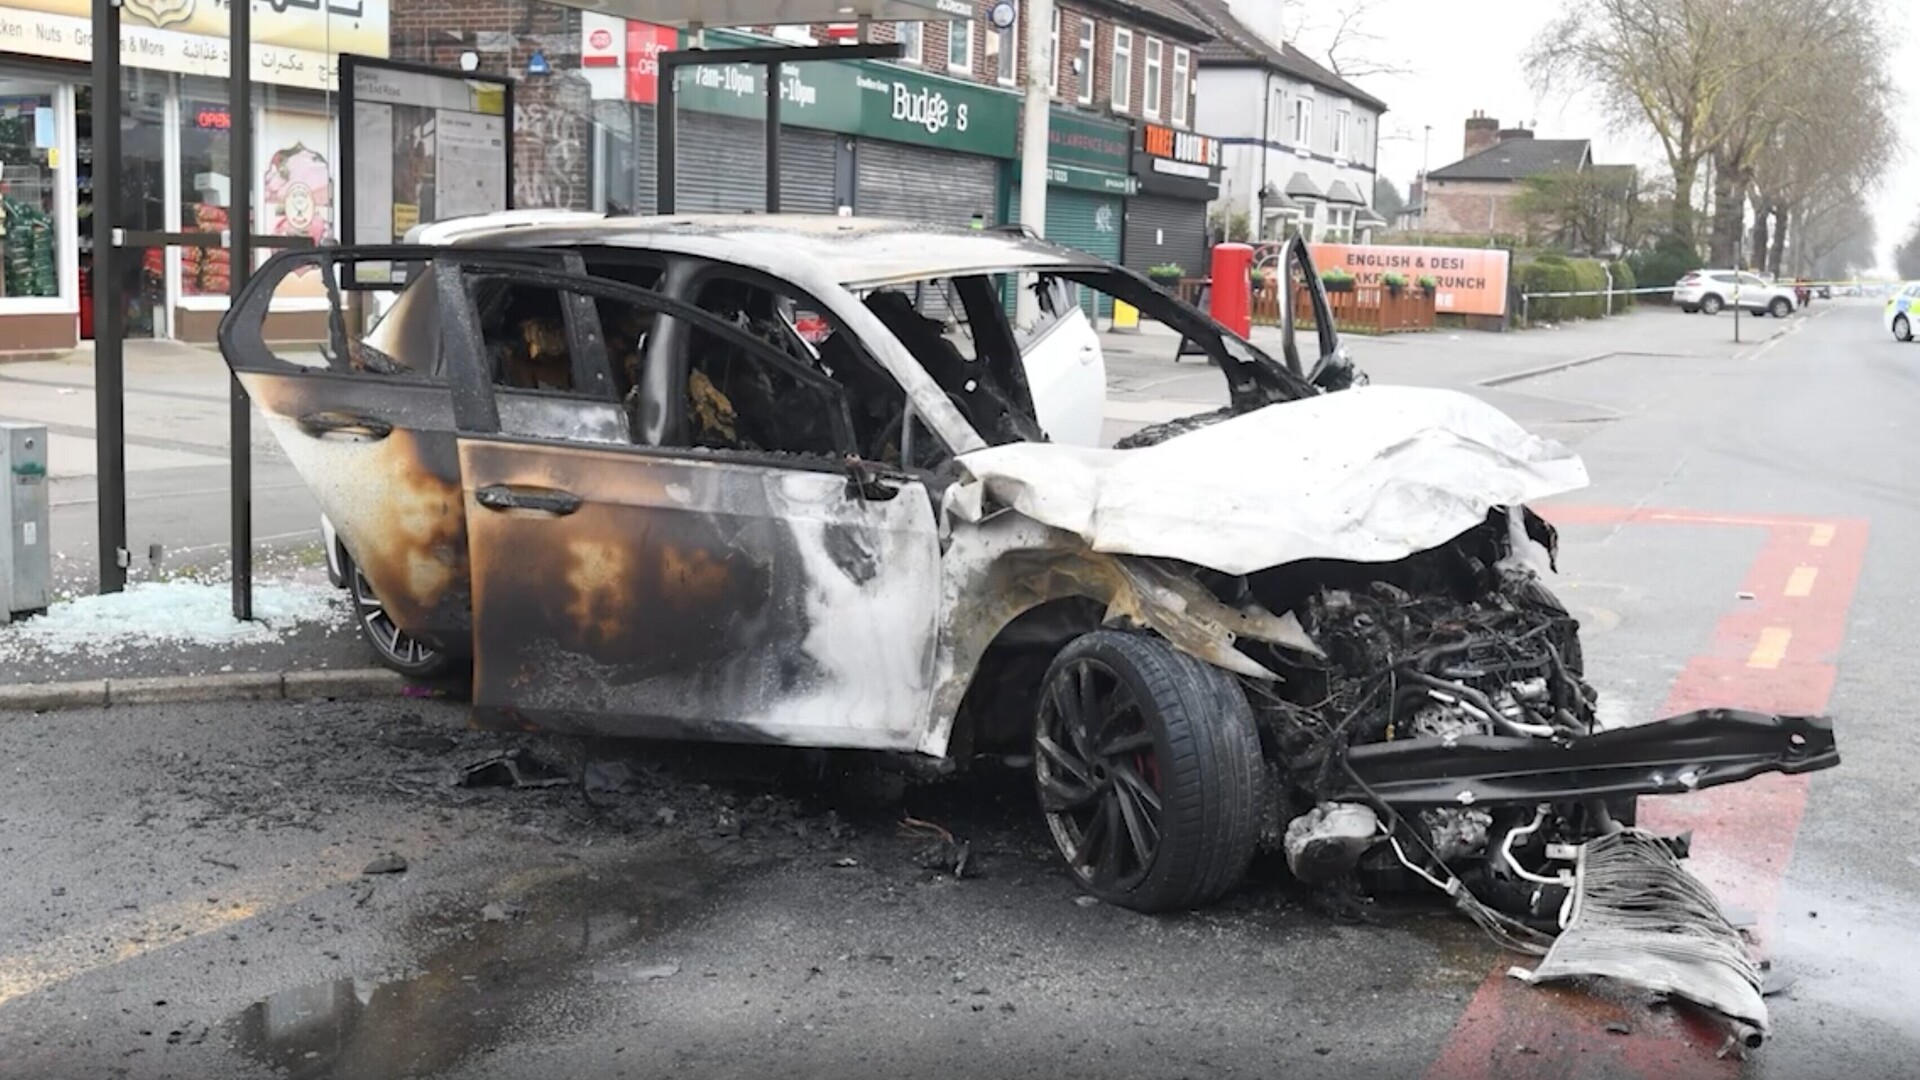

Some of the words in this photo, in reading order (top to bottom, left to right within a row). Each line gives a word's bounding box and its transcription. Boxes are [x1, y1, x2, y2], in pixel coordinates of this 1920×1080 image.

[36, 23, 61, 42] Nuts
[130, 36, 137, 52] &
[139, 38, 165, 56] More
[1346, 253, 1410, 268] ENGLISH
[1415, 254, 1425, 268] &
[1430, 256, 1465, 270] DESI
[1435, 276, 1486, 290] RUNCH
